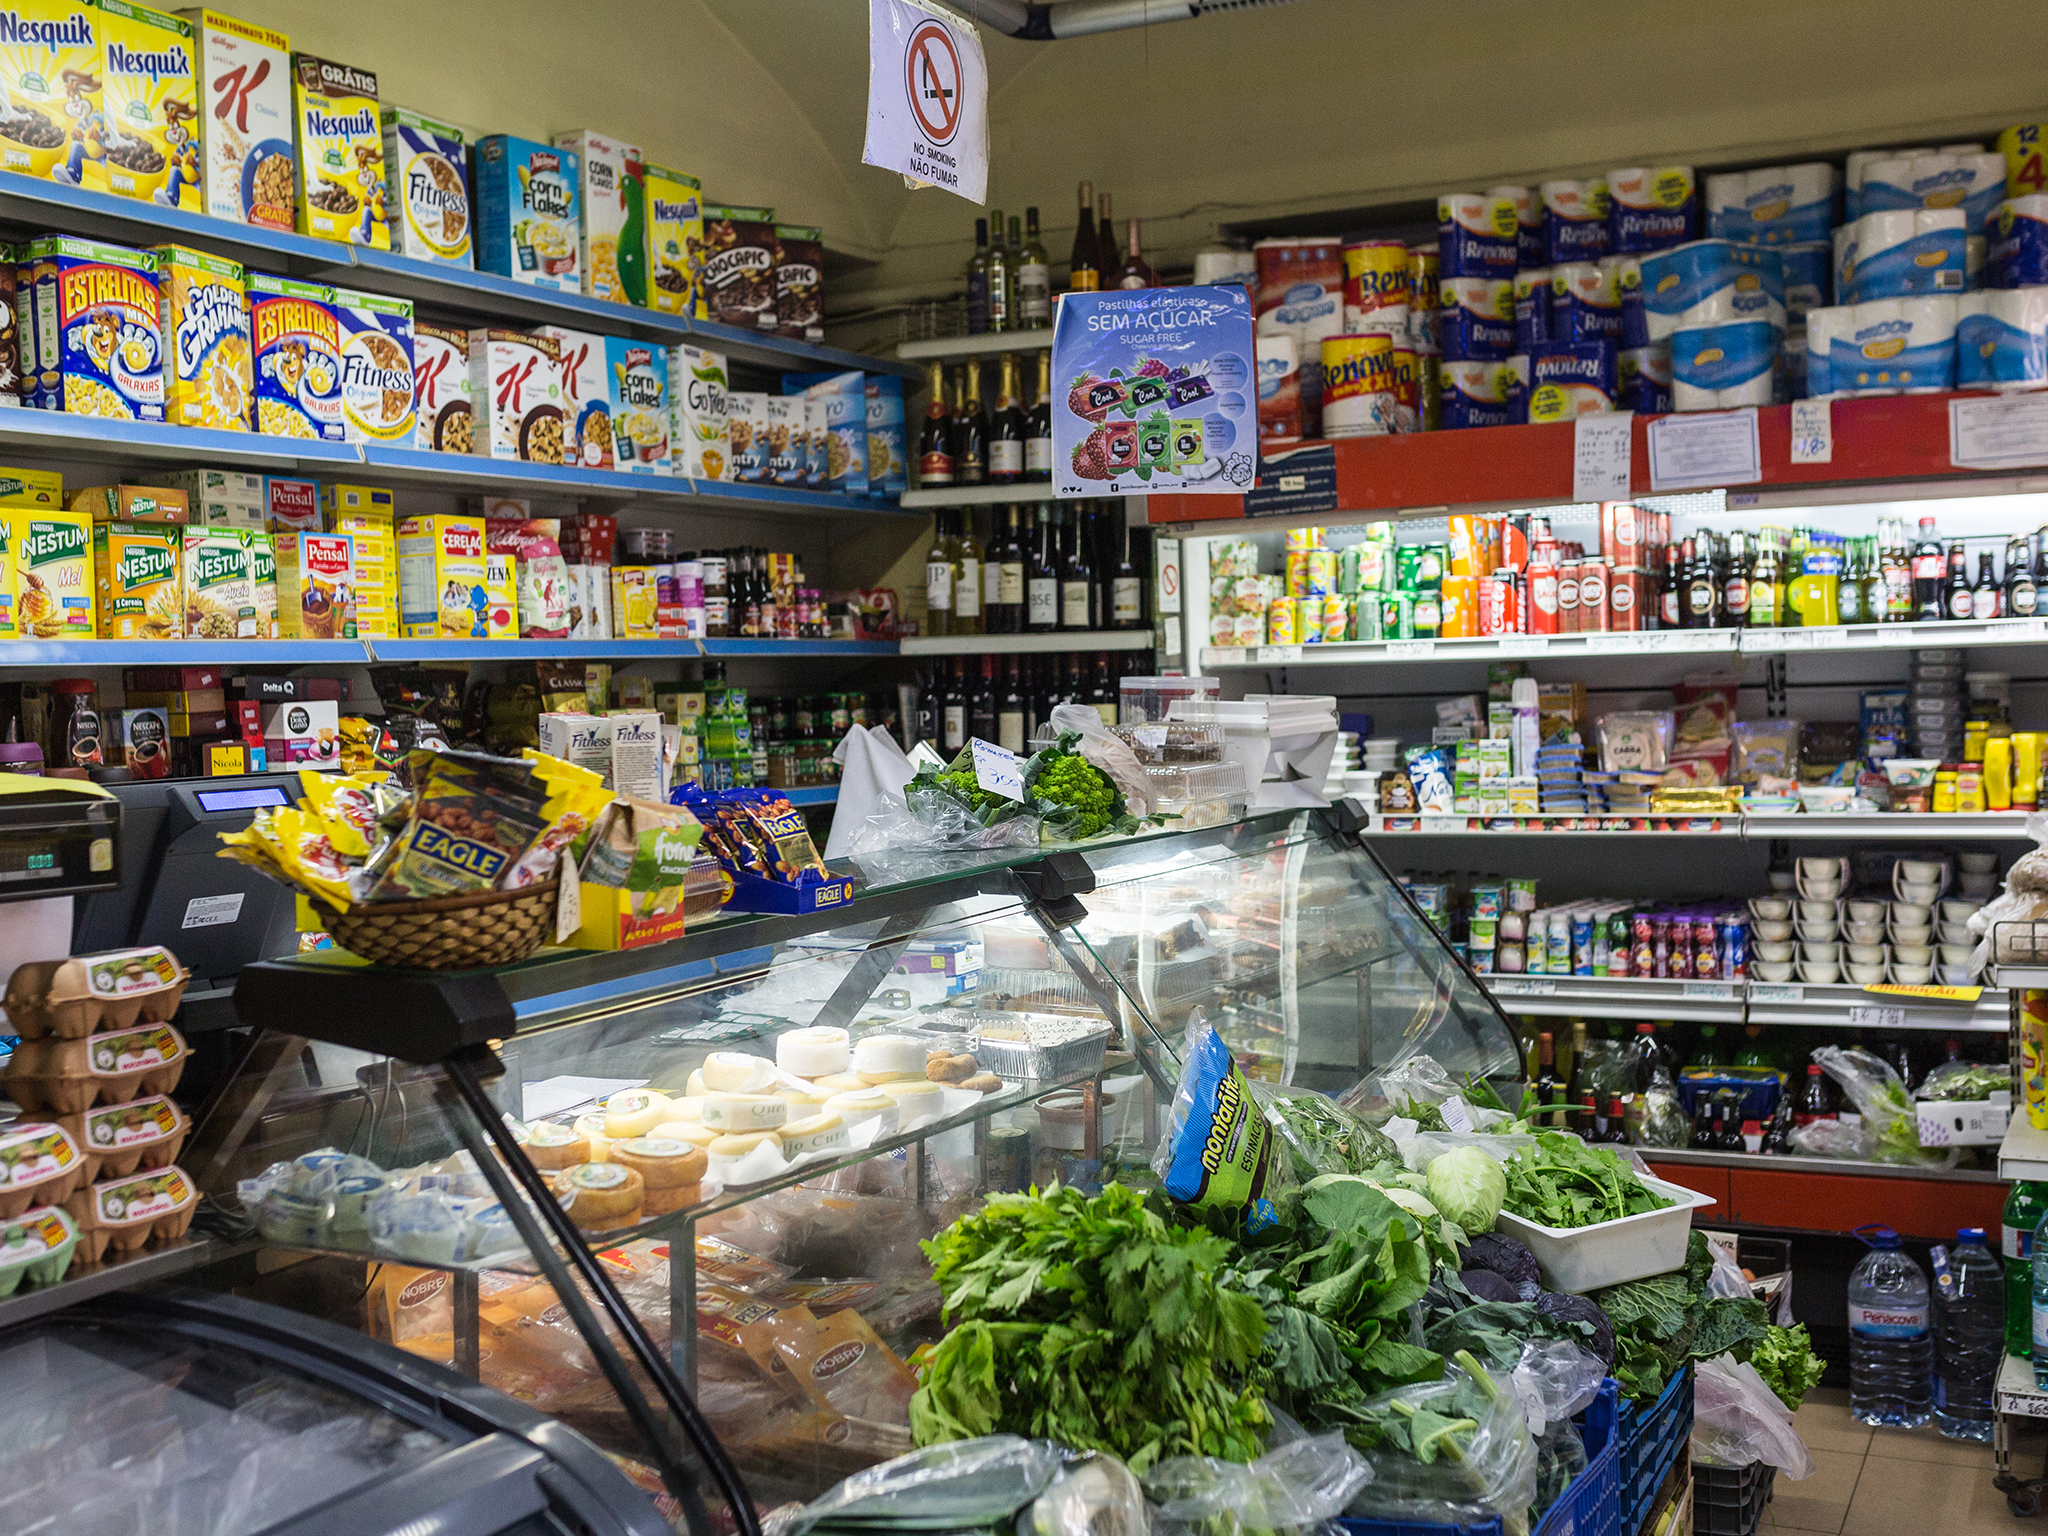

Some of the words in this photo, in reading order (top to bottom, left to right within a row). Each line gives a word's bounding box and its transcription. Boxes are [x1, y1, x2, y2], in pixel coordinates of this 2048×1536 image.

[0, 12, 94, 54] Nesquik
[207, 15, 227, 28] MAXI
[229, 21, 263, 39] FORMATO
[265, 32, 286, 50] 750g
[108, 44, 190, 85] Nesquik
[321, 63, 376, 94] GRÁTIS
[213, 59, 271, 133] K
[307, 110, 375, 144] Nesquik
[914, 142, 925, 155] NO
[927, 147, 956, 168] SMOKING
[589, 160, 613, 179] CORN
[910, 157, 929, 176] NÃO
[931, 166, 958, 188] FUMAR
[409, 172, 466, 214] Fitness
[528, 178, 563, 199] corn
[523, 192, 569, 219] Flakes
[1623, 214, 1685, 232] Renova
[706, 250, 764, 280] CHOCAPIC
[778, 266, 811, 285] CAPIC
[1362, 267, 1408, 296] Ren
[64, 269, 157, 320] ESTRELITAS
[183, 284, 242, 322] GOLDEN
[1098, 298, 1149, 311] Pastilhas
[1151, 297, 1201, 308] elásticas
[126, 307, 150, 327] MEL
[258, 303, 337, 349] ESTRELITAS
[1087, 314, 1130, 332] SEM
[310, 336, 331, 354] MEL
[1120, 334, 1155, 344] SUGAR
[1157, 332, 1182, 343] FREE
[117, 373, 160, 392] GALAXIAS
[342, 354, 412, 392] Fitness
[625, 373, 654, 391] corn
[496, 355, 538, 413] K
[1138, 386, 1157, 403] Cool
[1181, 385, 1199, 401] Cool
[304, 396, 340, 413] GALAXIAS
[620, 387, 661, 408] Flakes
[1095, 388, 1114, 406] Cool
[732, 454, 760, 469] ntry
[769, 455, 797, 471] ntry
[130, 499, 156, 513] NESTUM
[273, 488, 313, 508] Pensal
[21, 526, 89, 560] NESTUM
[441, 534, 482, 549] CERELAC
[307, 545, 347, 565] Pensal
[58, 565, 83, 588] Mel
[116, 550, 176, 582] NESTUM
[190, 551, 250, 582] NESTUM
[255, 559, 276, 577] TUM
[487, 567, 510, 581] ZENA
[224, 582, 249, 600] Aveia
[263, 683, 282, 693] Delta
[283, 681, 294, 695] Q
[133, 721, 162, 732] NESCAFÉ
[617, 727, 656, 741] Fitness
[572, 733, 612, 747] Fitness
[213, 758, 242, 769] Nicola
[770, 814, 804, 836] EAGLE
[417, 829, 498, 877] EAGLE
[818, 887, 840, 904] EAGLE
[1869, 983, 1956, 997] PROMOÇÃO
[1201, 1073, 1240, 1175] montañita
[783, 1139, 804, 1155] ijo
[812, 1128, 848, 1147] Cura
[1241, 1114, 1264, 1173] ESPINACAS
[1250, 1203, 1271, 1232] NUEVO
[400, 1276, 447, 1302] NOBRE
[735, 1302, 770, 1324] PERU
[1863, 1310, 1918, 1325] Penacova
[813, 1344, 864, 1377] NOBRE
